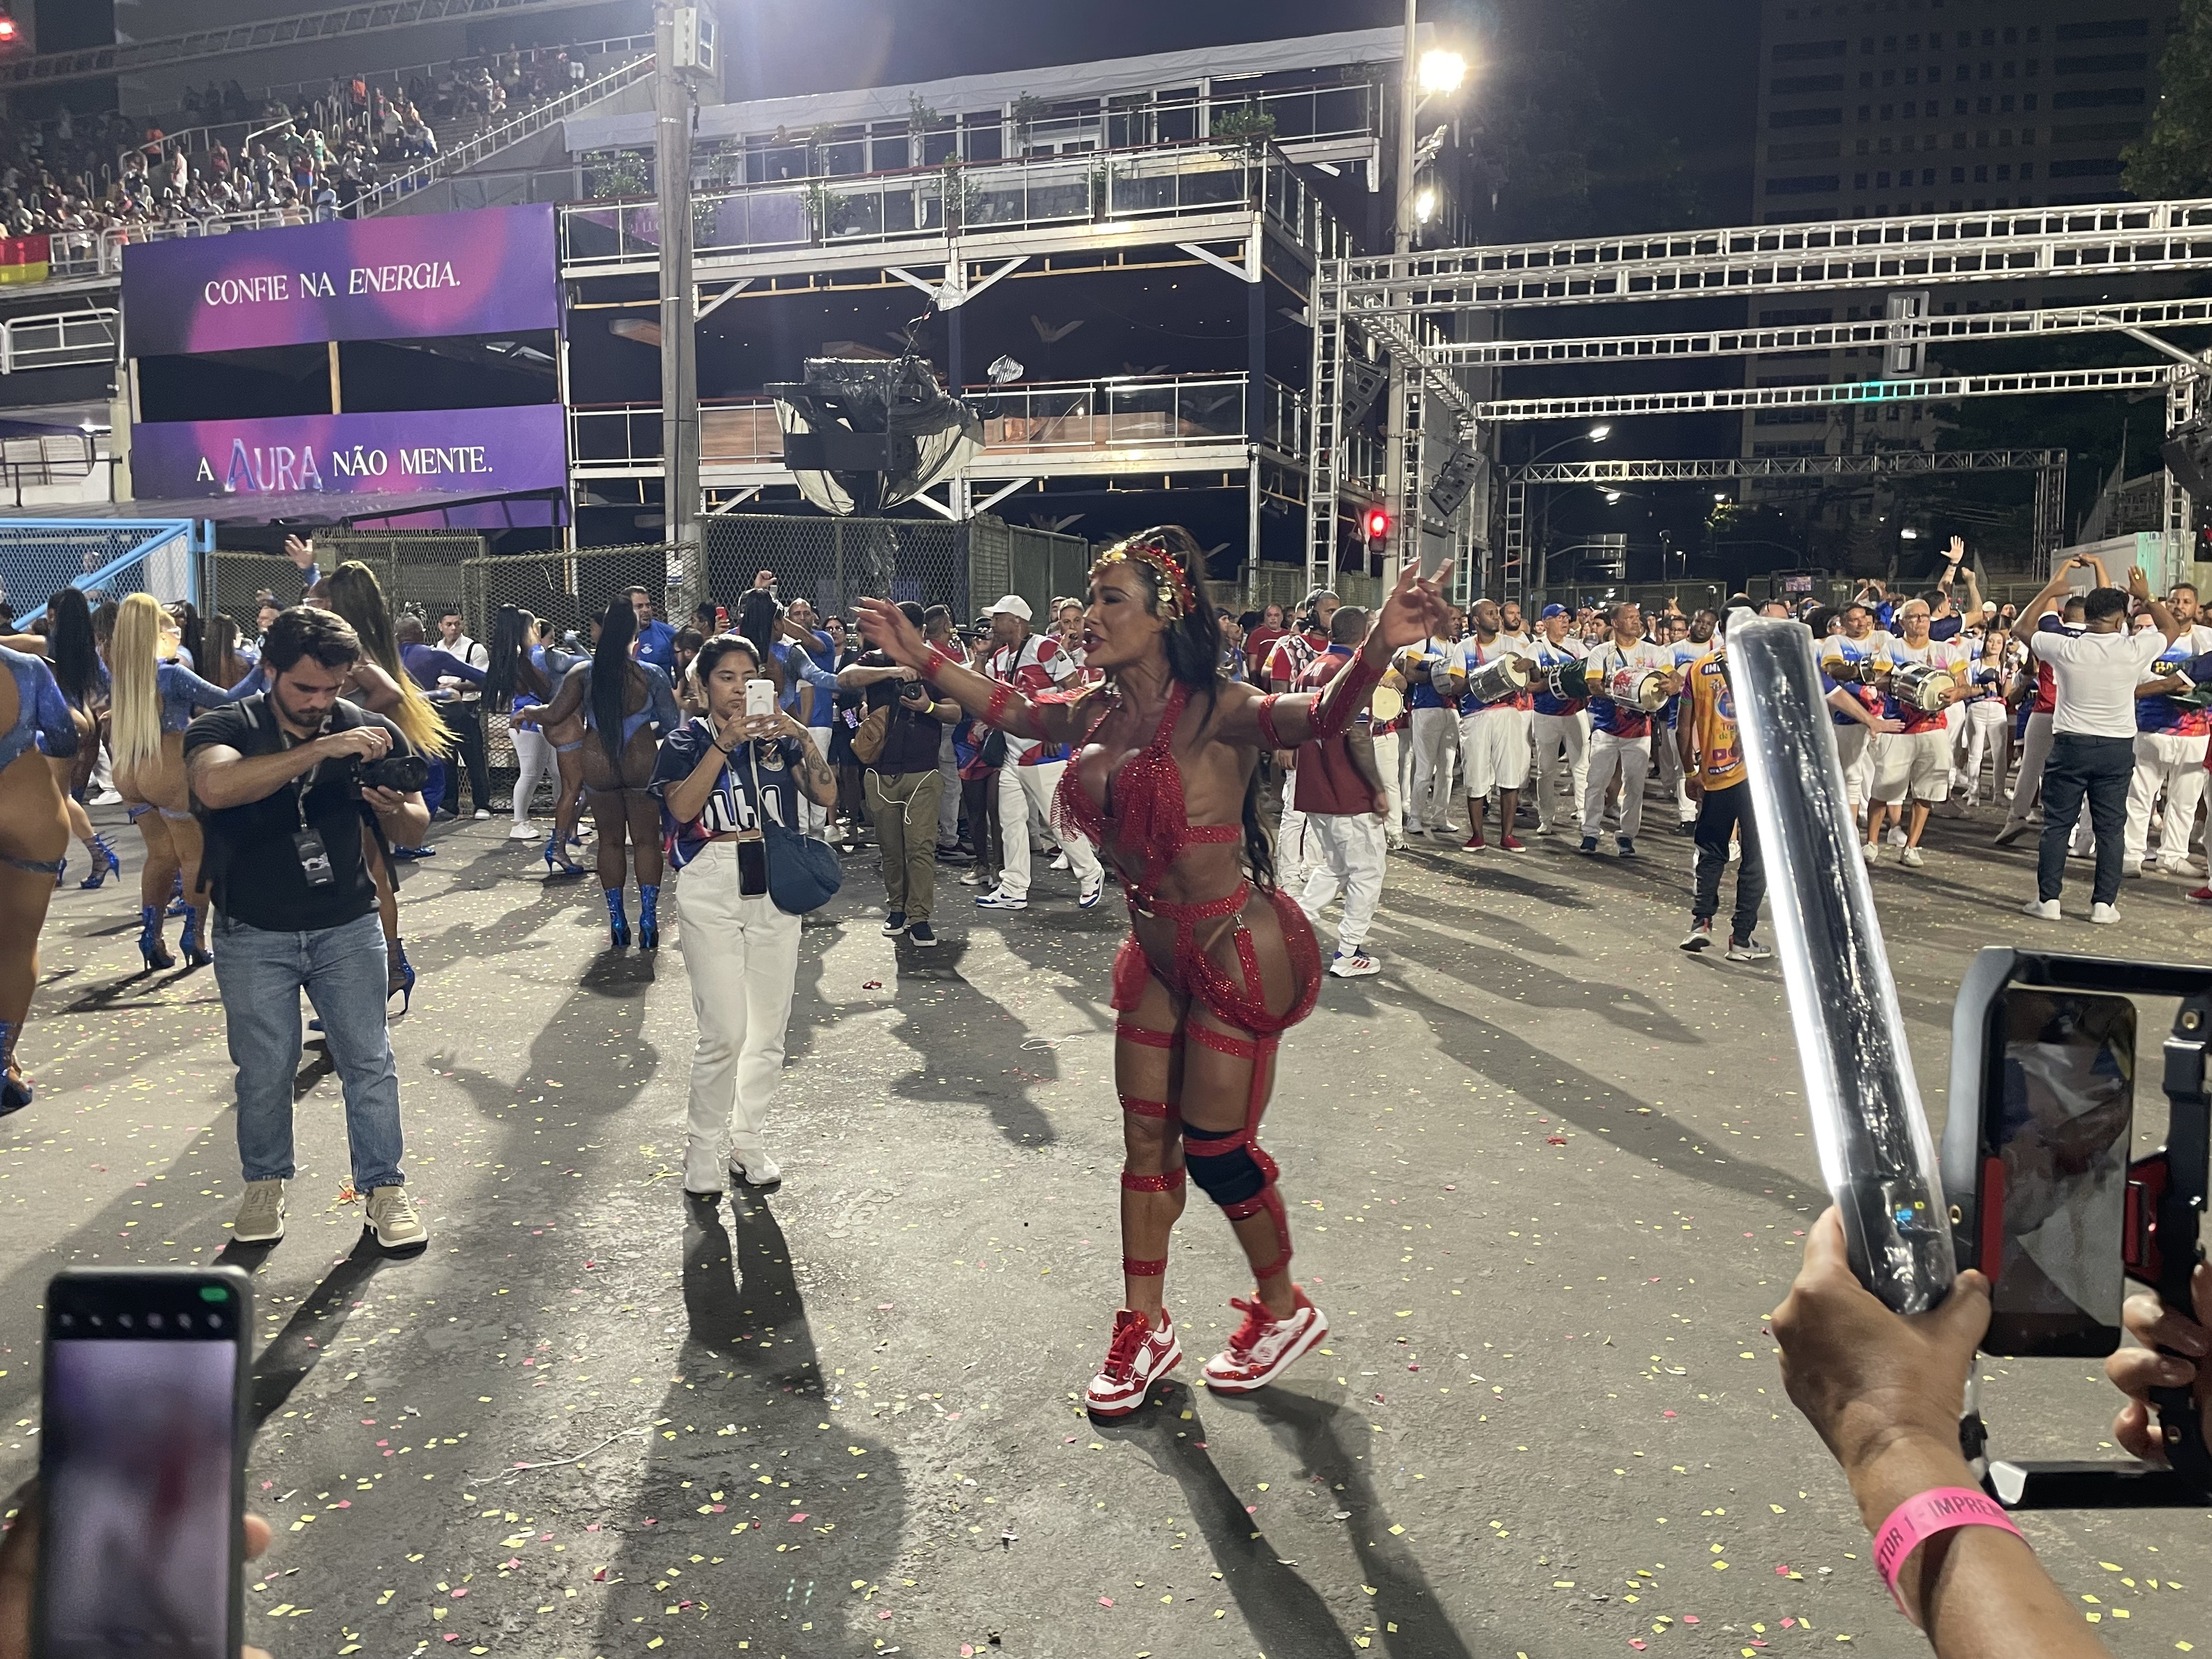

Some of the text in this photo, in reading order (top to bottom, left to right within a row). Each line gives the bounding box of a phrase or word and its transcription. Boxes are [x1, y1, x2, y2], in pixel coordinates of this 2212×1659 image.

[205, 261, 461, 306] CONFIE NA ENERGIA.
[196, 438, 493, 492] A AURA NÃO MENTE.
